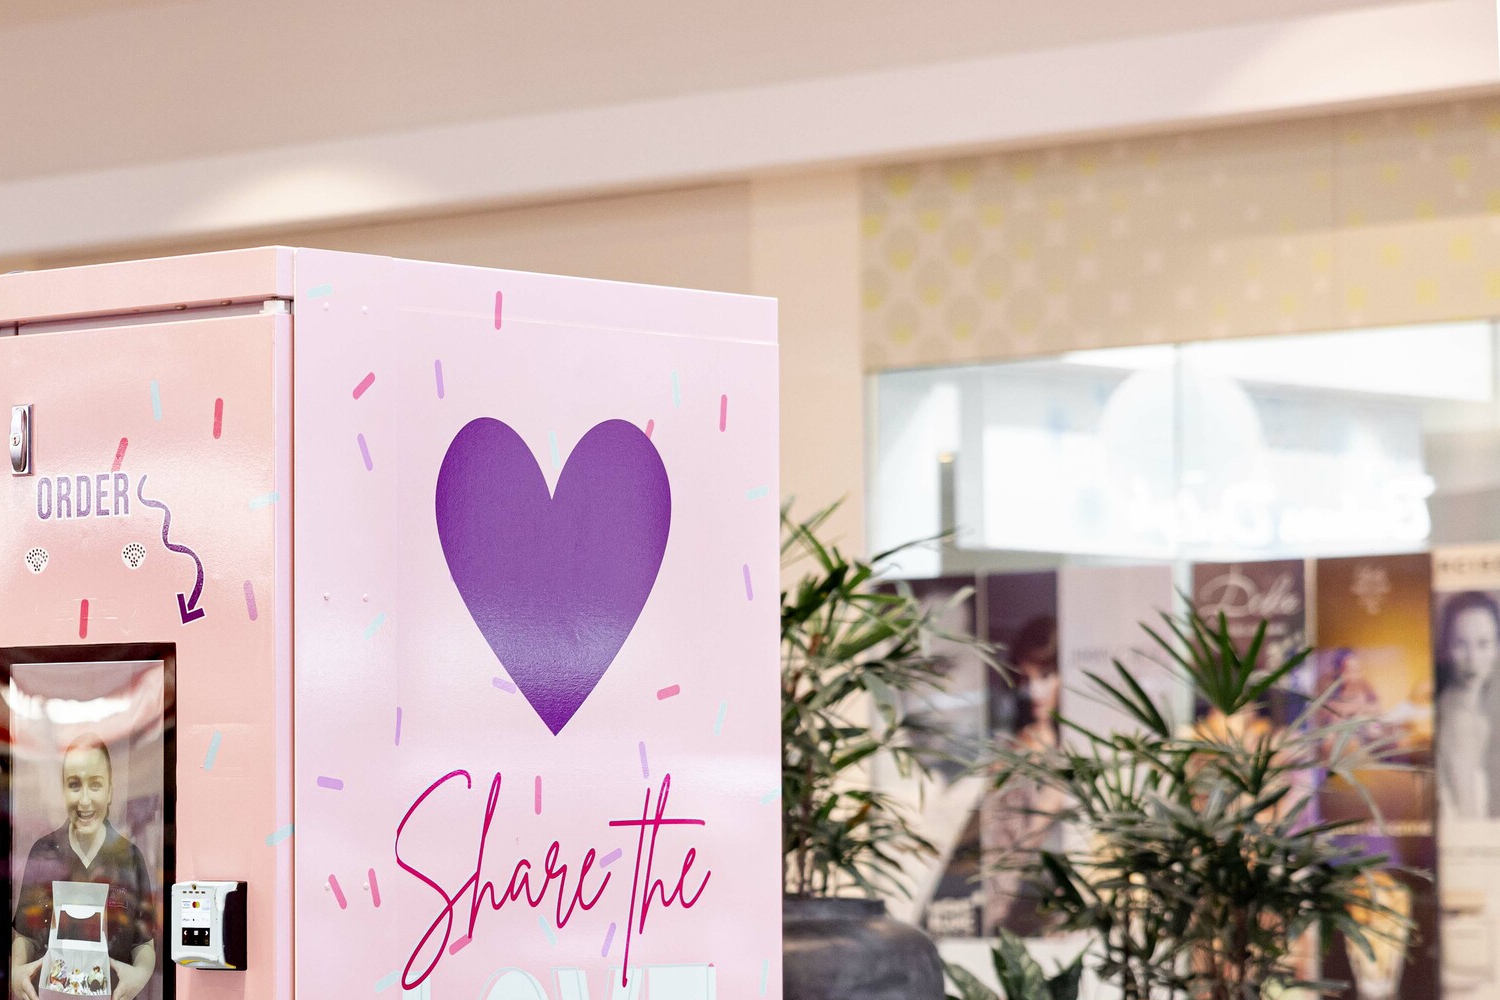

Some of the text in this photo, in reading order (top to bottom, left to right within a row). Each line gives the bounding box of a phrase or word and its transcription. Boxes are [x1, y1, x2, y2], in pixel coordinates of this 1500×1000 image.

[37, 472, 129, 520] ORDER
[395, 769, 712, 990] Share the
